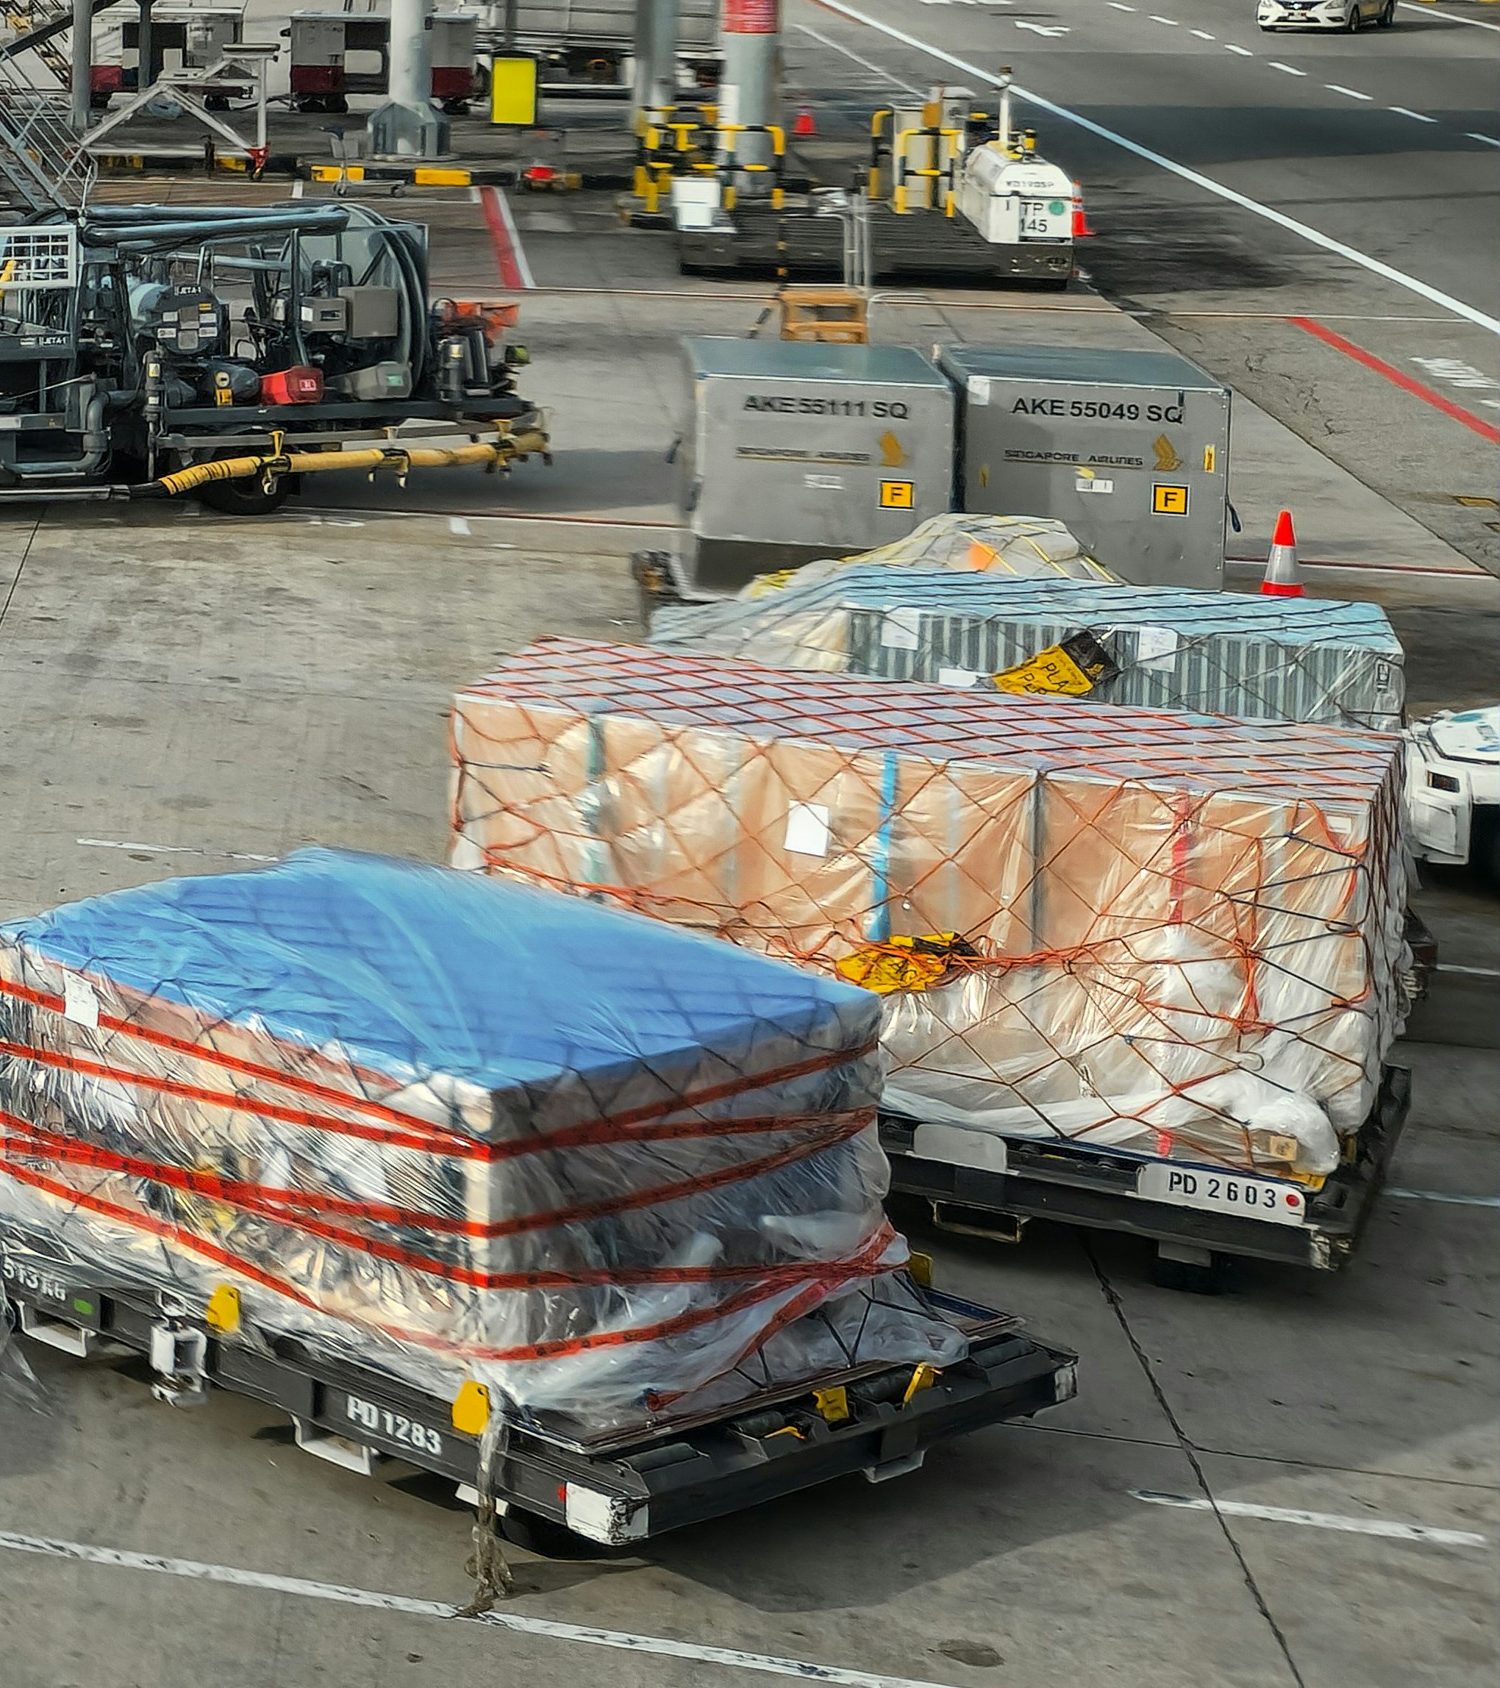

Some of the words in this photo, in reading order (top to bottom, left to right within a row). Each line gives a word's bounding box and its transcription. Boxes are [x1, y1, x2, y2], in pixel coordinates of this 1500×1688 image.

[744, 395, 795, 414] AKE
[799, 397, 865, 417] 55111
[871, 400, 909, 420] SQ
[1011, 397, 1065, 417] AKE
[1070, 401, 1140, 421] 55049
[1146, 404, 1184, 424] SQ
[1004, 449, 1080, 462] SINGAPORE
[1087, 454, 1144, 466] AIRLINES
[890, 486, 904, 503] F
[1163, 491, 1178, 508] F
[1169, 1171, 1198, 1195] PD
[1207, 1178, 1277, 1209] 2603
[346, 1394, 380, 1430] PD
[381, 1408, 443, 1455] 1283
